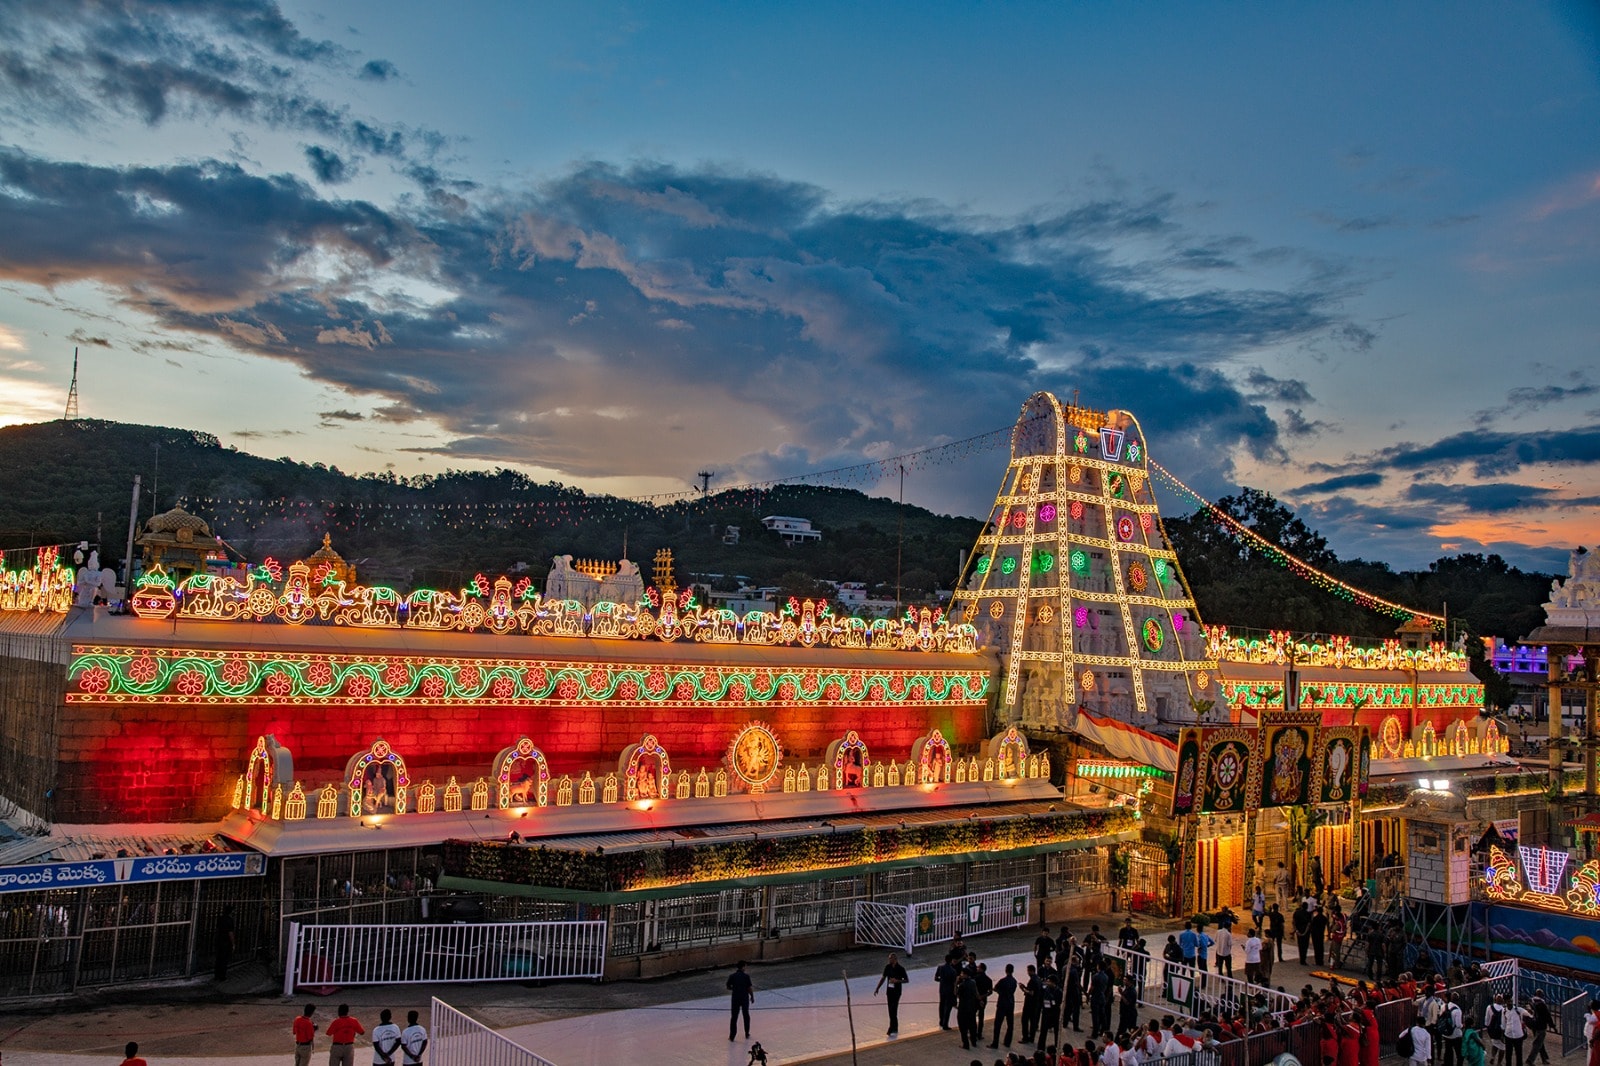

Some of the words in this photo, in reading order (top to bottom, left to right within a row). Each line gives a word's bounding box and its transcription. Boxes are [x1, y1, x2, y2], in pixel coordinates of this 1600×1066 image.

[56, 864, 107, 882] మొక్కు
[141, 857, 191, 875] శిరము
[194, 856, 242, 873] శిరము
